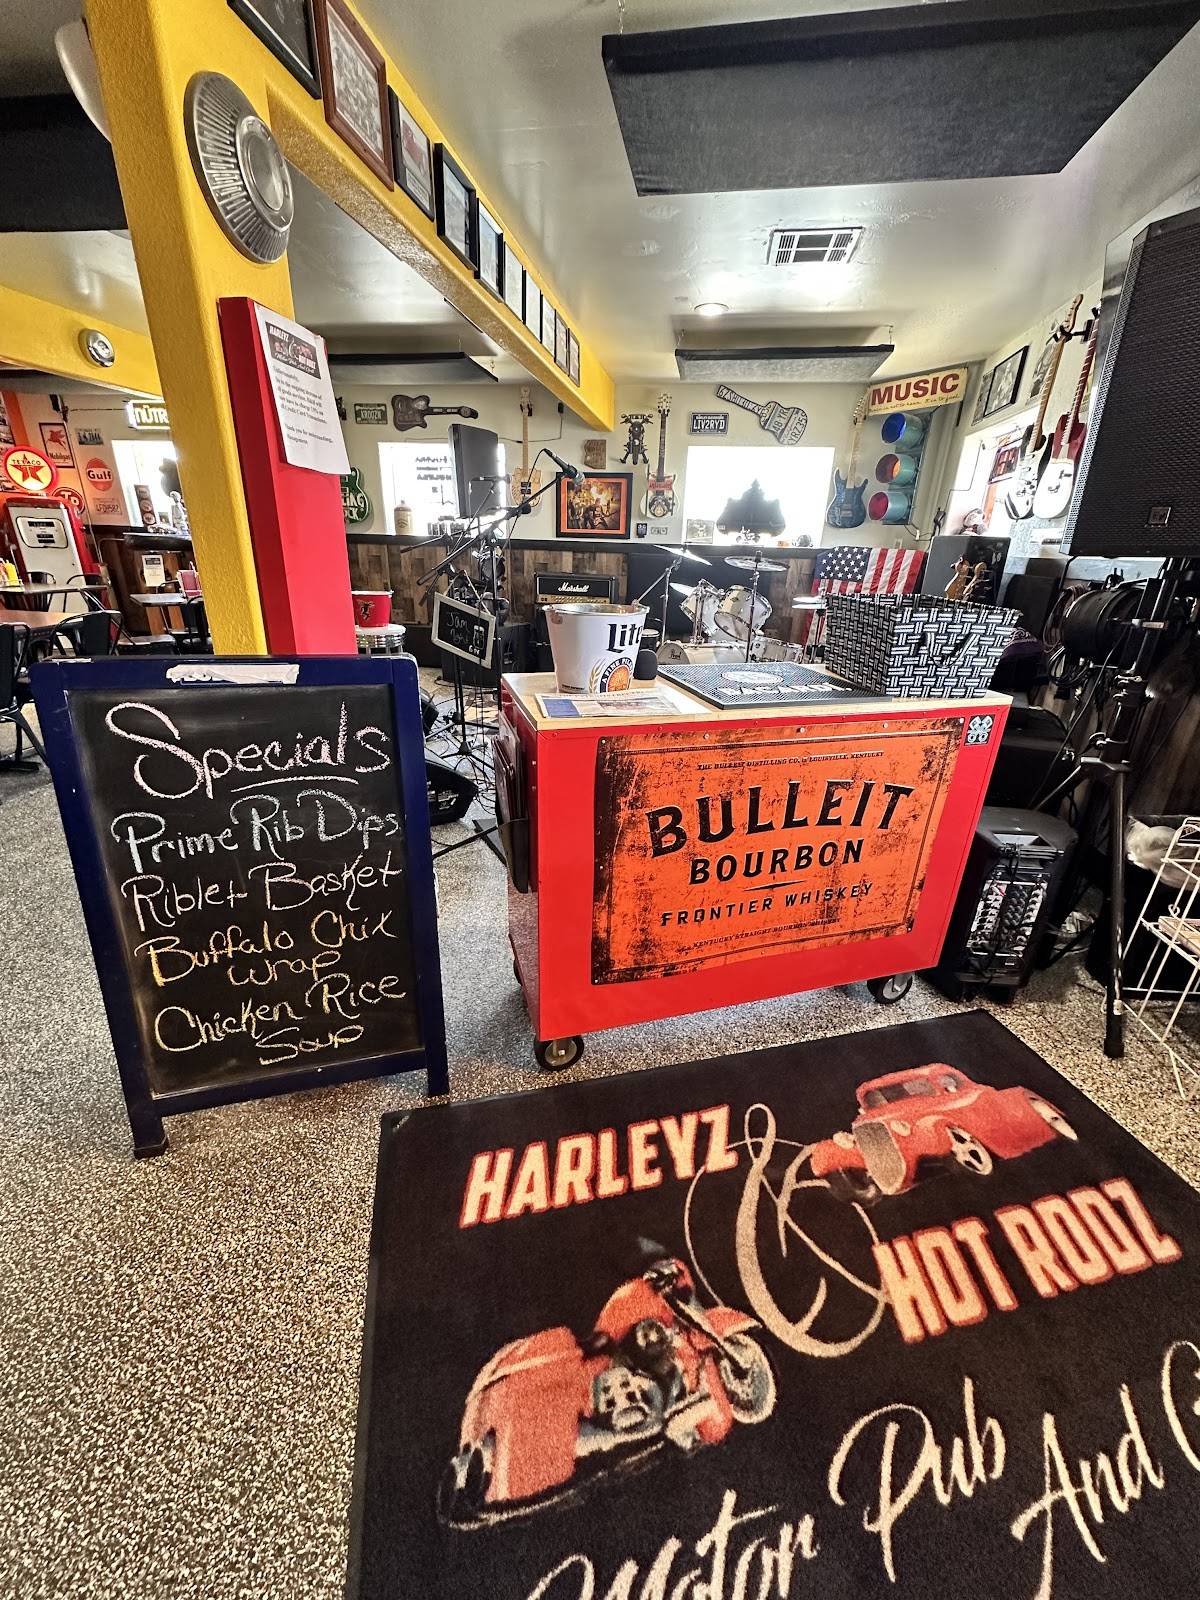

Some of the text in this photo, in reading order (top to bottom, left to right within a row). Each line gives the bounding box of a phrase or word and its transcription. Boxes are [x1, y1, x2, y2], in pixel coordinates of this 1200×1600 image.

[871, 373, 960, 406] MUSIC
[693, 419, 725, 430] LIV2RYD
[87, 469, 112, 480] Gulf
[558, 581, 590, 593] Marshall
[104, 701, 392, 800] Specials
[746, 758, 788, 767] DISTILLING
[111, 788, 400, 874] Prime Rib Dips
[645, 779, 915, 858] BULLEIT
[120, 850, 403, 932] Riblet Basket
[689, 838, 865, 886] BOURBON
[660, 882, 874, 927] FRONTIER WHISKEY
[134, 909, 398, 987] Buffalo Chix
[692, 934, 734, 950] KENTUCKY
[734, 928, 771, 940] STRAIGHT
[154, 972, 407, 1053] Chicken Rice
[255, 1025, 364, 1066] Soup
[459, 1104, 739, 1230] HARLEYZ
[870, 1176, 1184, 1345] HOT RODZ
[827, 1375, 1006, 1583] Pub
[1011, 1382, 1165, 1600] And
